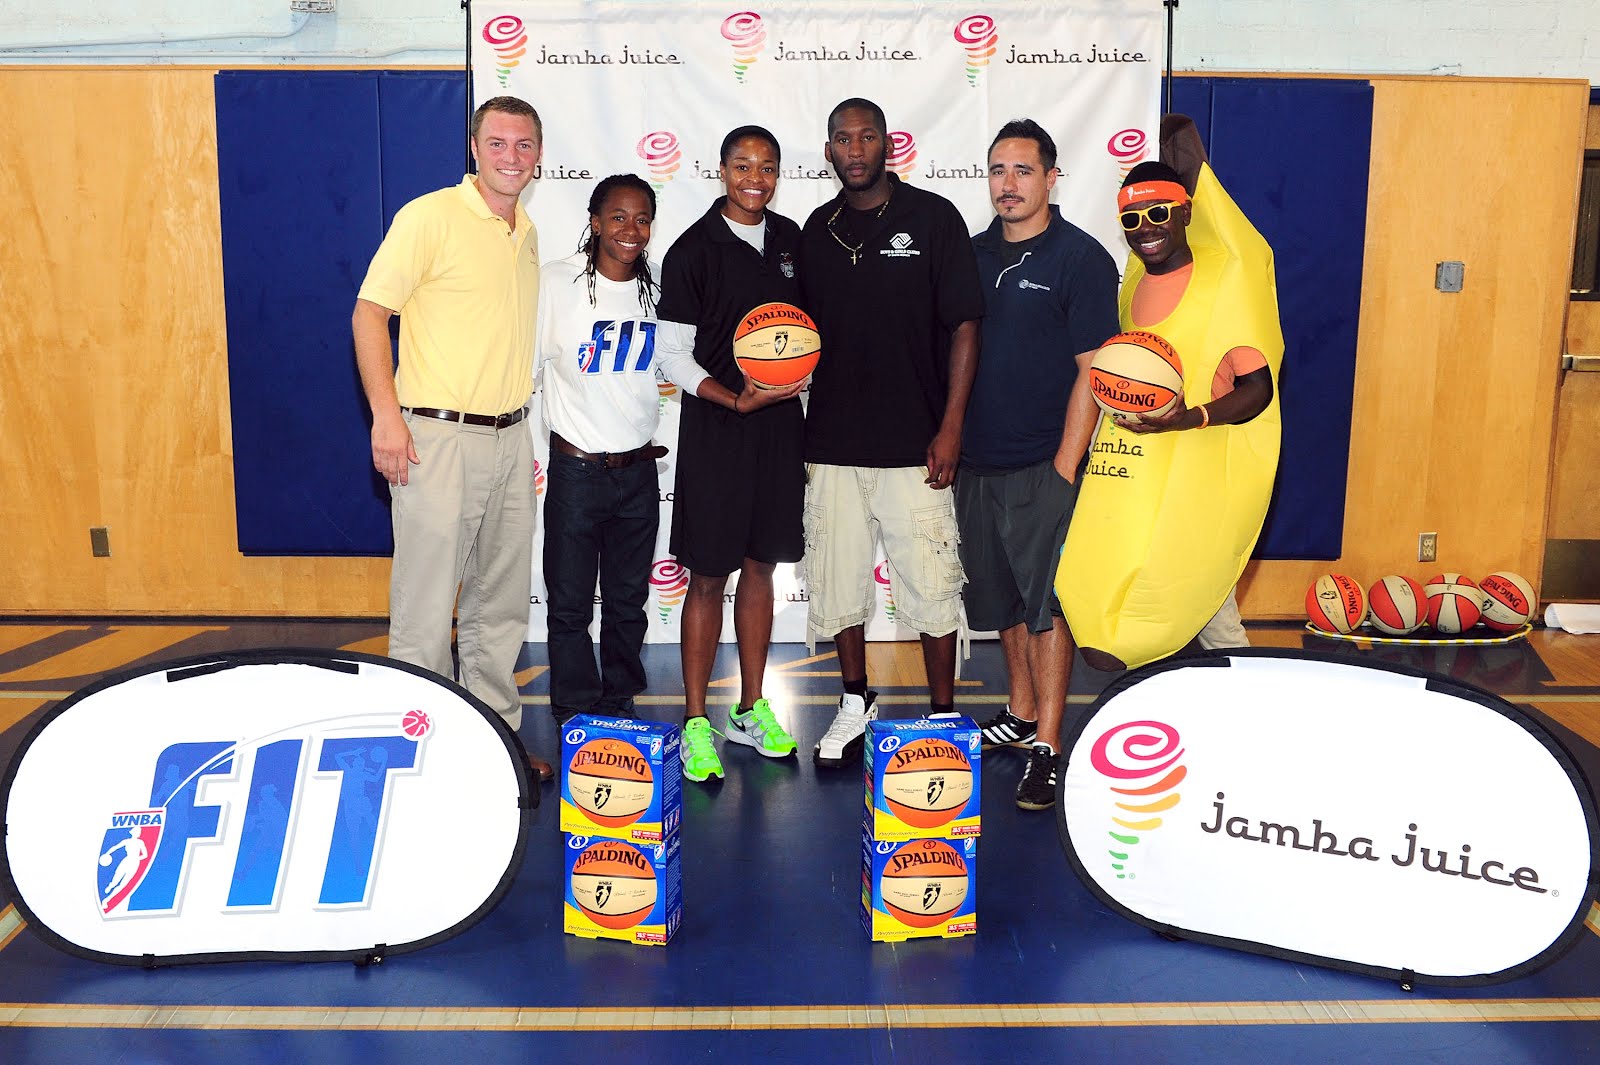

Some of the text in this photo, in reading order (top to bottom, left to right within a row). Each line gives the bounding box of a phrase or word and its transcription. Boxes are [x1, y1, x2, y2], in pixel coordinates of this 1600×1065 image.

[536, 45, 614, 65] jamba
[774, 42, 851, 61] jamba
[1006, 44, 1082, 64] jamba
[780, 165, 833, 180] uice
[925, 160, 989, 179] jamb
[746, 310, 810, 331] SPALDING
[587, 319, 658, 374] FIT
[1092, 376, 1157, 408] SPALDING
[1093, 438, 1145, 457] amba
[1335, 575, 1359, 615] SPALDING
[1482, 578, 1522, 609] SPALDING
[574, 750, 647, 776] SPALDING
[111, 813, 162, 828] WNBA
[127, 735, 421, 913] FIT
[1200, 791, 1549, 894] jamba juice
[576, 849, 647, 871] SPALDING
[892, 851, 965, 873] SPALDING
